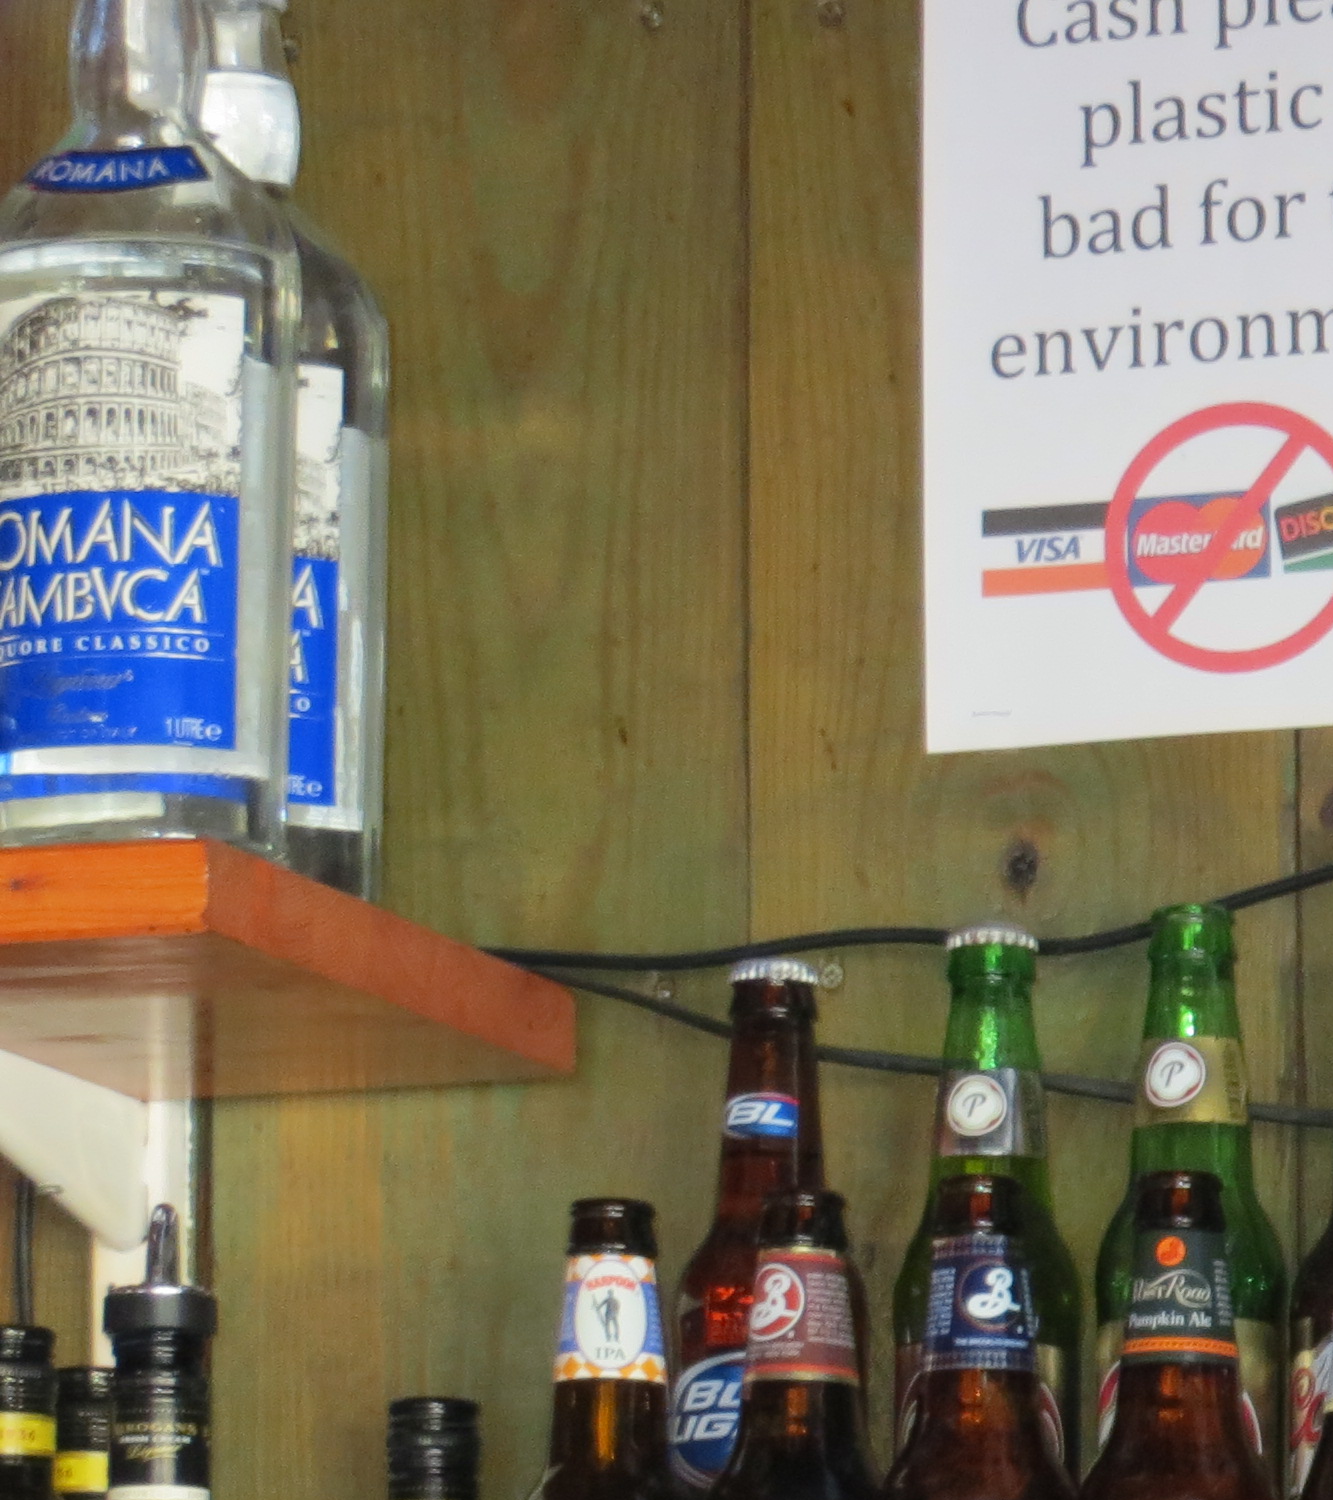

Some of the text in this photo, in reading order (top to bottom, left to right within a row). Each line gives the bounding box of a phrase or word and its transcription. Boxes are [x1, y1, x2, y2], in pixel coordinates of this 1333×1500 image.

[1080, 70, 1324, 168] plastic
[1039, 184, 1170, 259] bad
[1199, 178, 1306, 246] for
[0, 498, 223, 571] OMANA
[1013, 536, 1082, 563] VISA
[1136, 524, 1264, 558] Masterrd
[0, 566, 207, 629] AMBVCA
[74, 634, 211, 655] CLASSICO
[726, 1101, 795, 1127] BL
[594, 1346, 627, 1361] IPA
